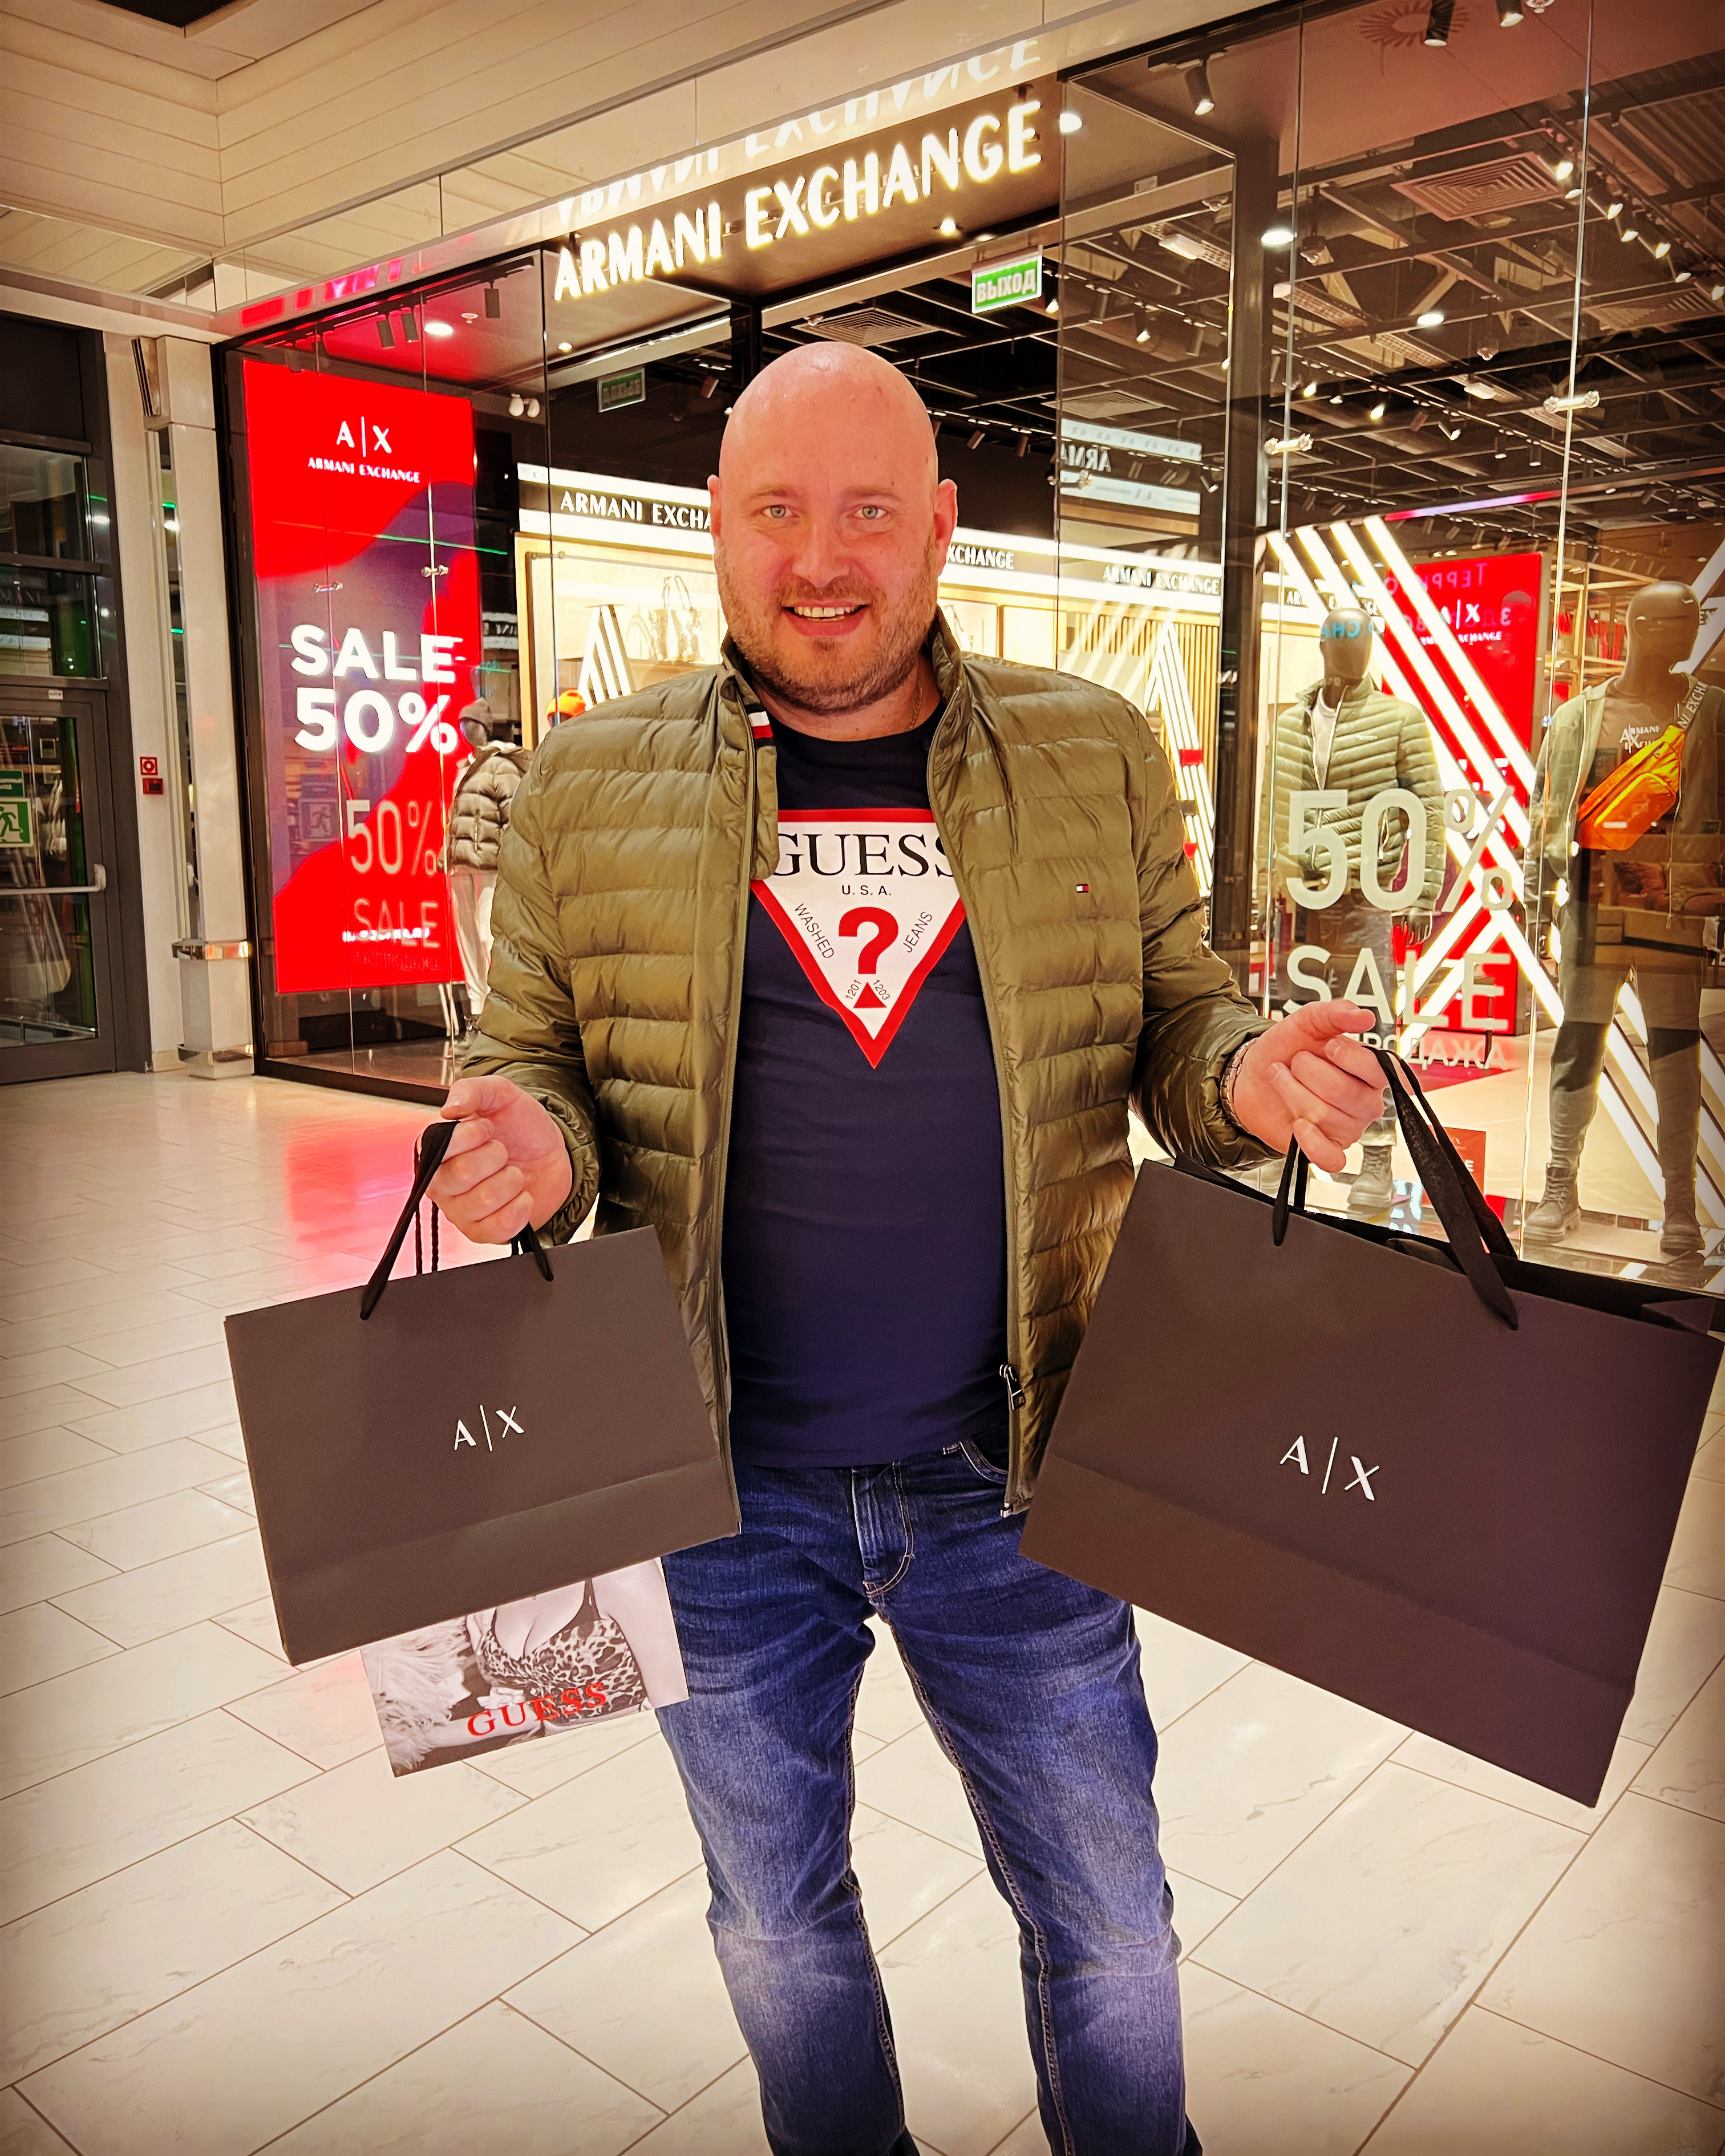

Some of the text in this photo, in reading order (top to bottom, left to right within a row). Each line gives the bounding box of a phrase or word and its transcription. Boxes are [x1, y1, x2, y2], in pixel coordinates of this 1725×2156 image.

[553, 202, 723, 301] ARMANI
[744, 100, 1042, 249] EXCHANGE
[976, 269, 1036, 303] ВЫХОД
[308, 457, 420, 483] ARMANI EXCHANGE
[560, 491, 643, 521] ARMANI
[1102, 565, 1220, 595] ARMANI EXCHANGE
[291, 624, 457, 683] SALE
[294, 687, 457, 753] 50%
[346, 799, 438, 877] 50%
[1285, 787, 1515, 913] 50%
[353, 898, 440, 949] SALE
[795, 903, 835, 959] WASHED
[902, 911, 933, 954] JEANS
[845, 979, 862, 1000] 1201
[872, 979, 891, 1001] 1203
[1282, 945, 1511, 1031] SALE
[467, 1681, 608, 1737] GUESS
